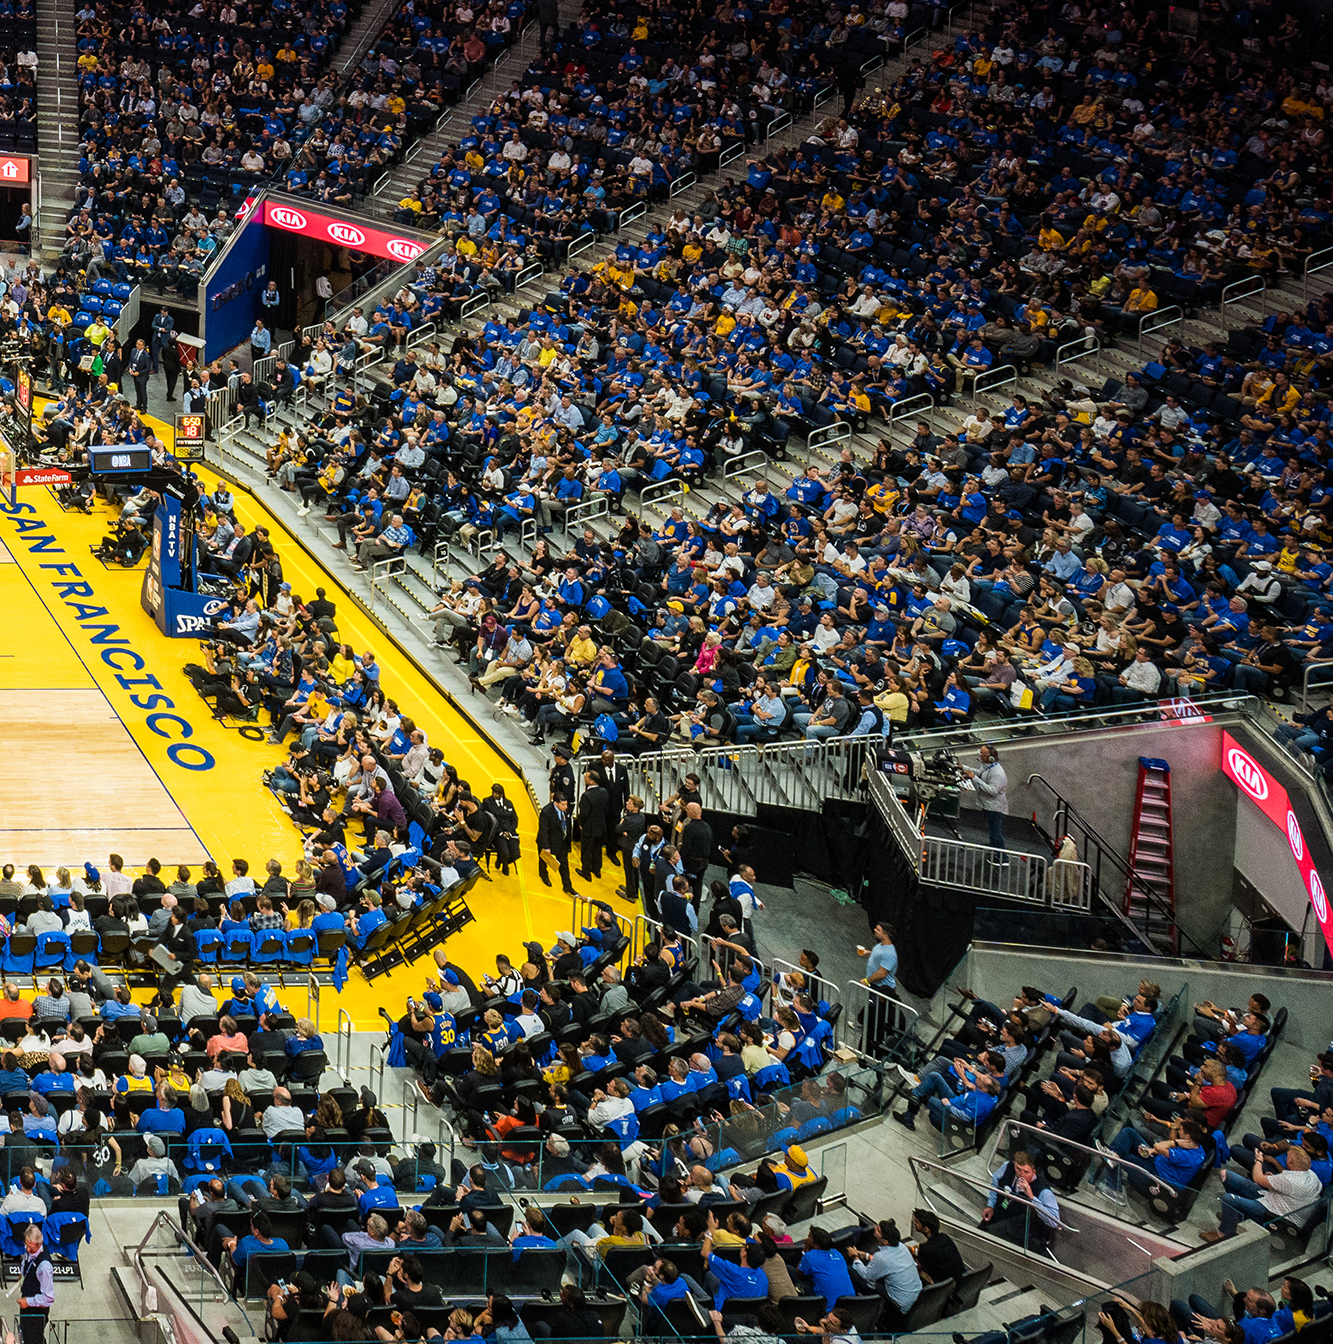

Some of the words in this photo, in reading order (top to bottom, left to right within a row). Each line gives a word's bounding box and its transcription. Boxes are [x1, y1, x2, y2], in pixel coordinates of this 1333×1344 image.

[334, 226, 359, 242] KIA
[111, 455, 131, 467] @NBA
[38, 561, 216, 773] FRANCISCO
[440, 1029, 455, 1045] 30
